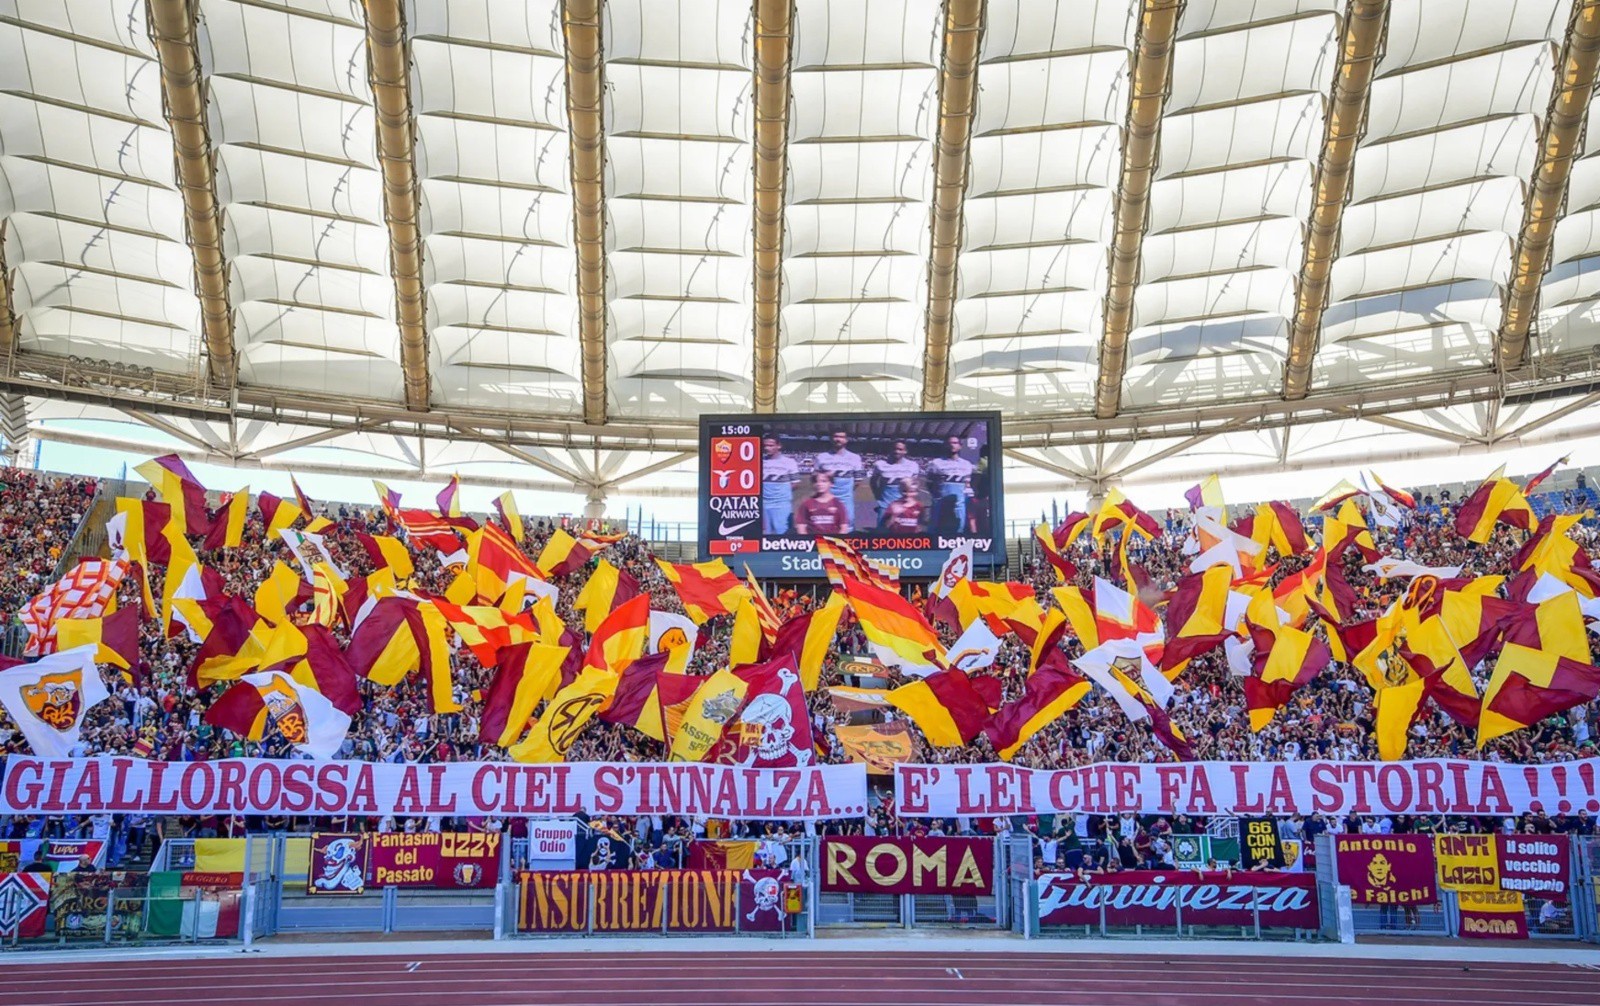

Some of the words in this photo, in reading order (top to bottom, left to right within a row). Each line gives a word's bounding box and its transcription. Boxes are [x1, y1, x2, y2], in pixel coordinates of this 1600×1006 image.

[721, 425, 750, 435] 15:00
[740, 441, 754, 461] 0
[740, 469, 754, 489] 0
[709, 496, 759, 513] QATAR
[721, 510, 760, 519] AIRWAYS
[762, 537, 815, 552] betway
[872, 538, 931, 550] SPONSOR
[782, 554, 825, 571] Stad
[6, 759, 378, 811] GIALLOROSSA
[394, 765, 456, 812] AL
[472, 764, 581, 813] CIEL
[955, 766, 1033, 813] LEI
[1049, 765, 1142, 812] CHE
[1156, 765, 1217, 812] FA
[1230, 765, 1298, 812] LA
[1310, 762, 1513, 812] STORIA
[534, 828, 573, 841] Gruppo
[1248, 822, 1272, 834] 66
[373, 832, 438, 848] Fantasmi
[441, 833, 500, 858] OZZY
[540, 840, 566, 853] Odio
[1247, 834, 1275, 847] CON
[1338, 839, 1417, 853] Antonio
[1251, 847, 1275, 860] NOI
[1518, 841, 1558, 856] solito
[395, 848, 417, 866] del
[827, 841, 985, 888] ROMA
[376, 866, 434, 883] Passato
[1505, 859, 1561, 874] vecchio
[1501, 877, 1565, 892] manipolo
[1038, 872, 1311, 918] Giovinezza
[1365, 886, 1429, 903] Falchi
[1464, 917, 1519, 934] ROMA
